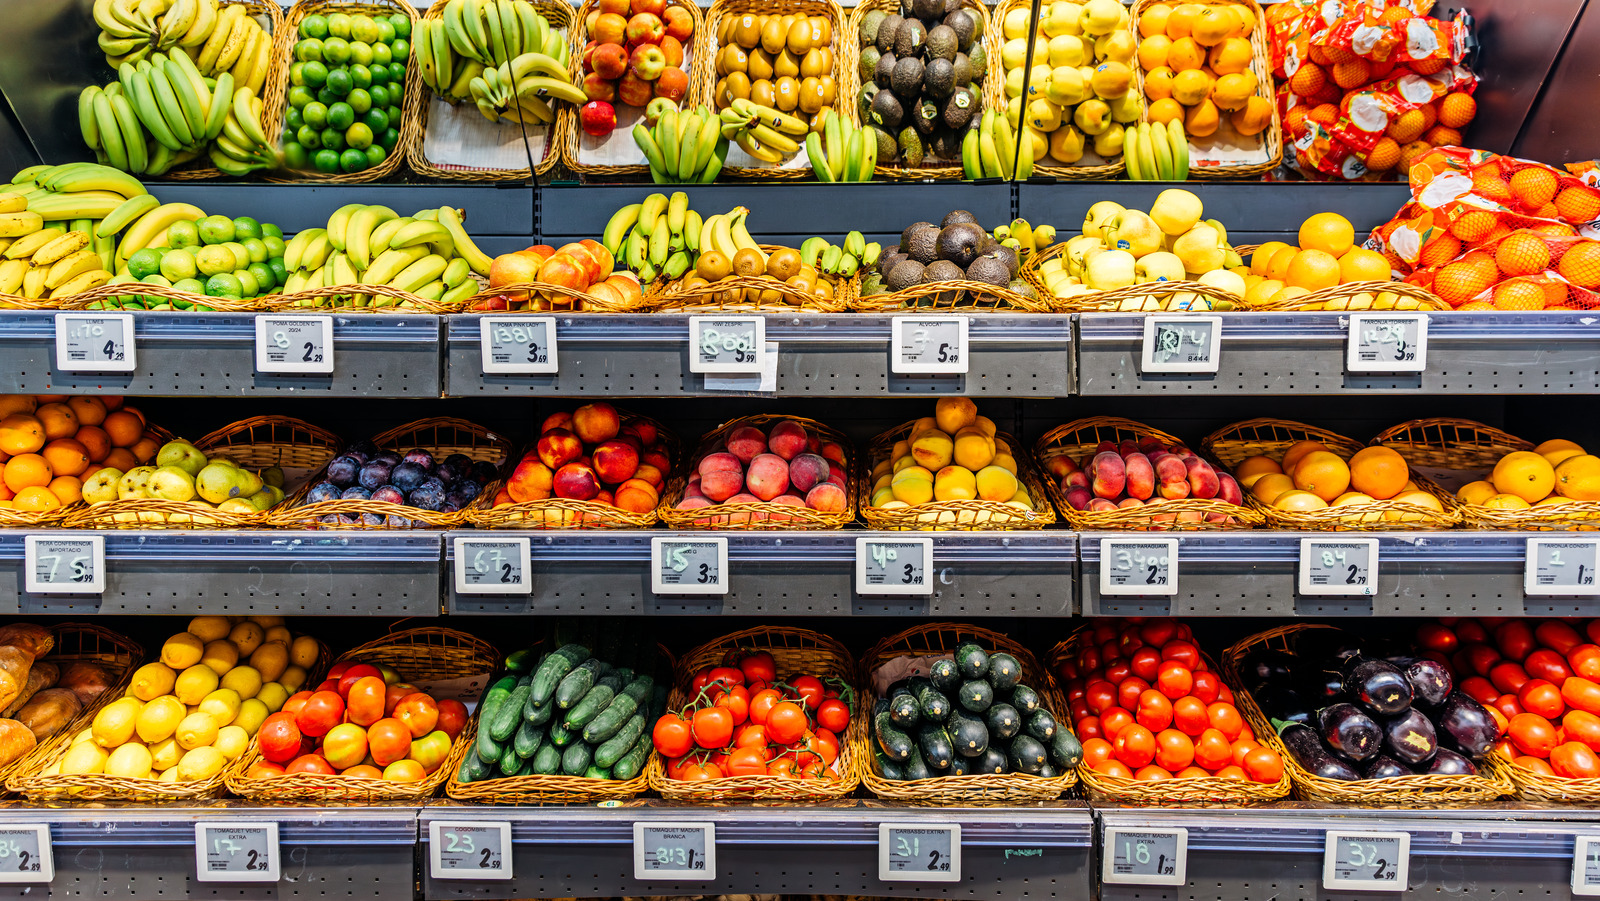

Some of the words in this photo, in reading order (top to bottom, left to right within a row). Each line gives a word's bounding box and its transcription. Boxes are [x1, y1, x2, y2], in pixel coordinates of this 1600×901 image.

[474, 549, 507, 573] 67
[1322, 550, 1346, 567] 84
[214, 839, 242, 856] 17
[444, 833, 475, 854] 23
[897, 837, 919, 857] 31
[1126, 842, 1150, 864] 18
[1349, 843, 1382, 867] 32
